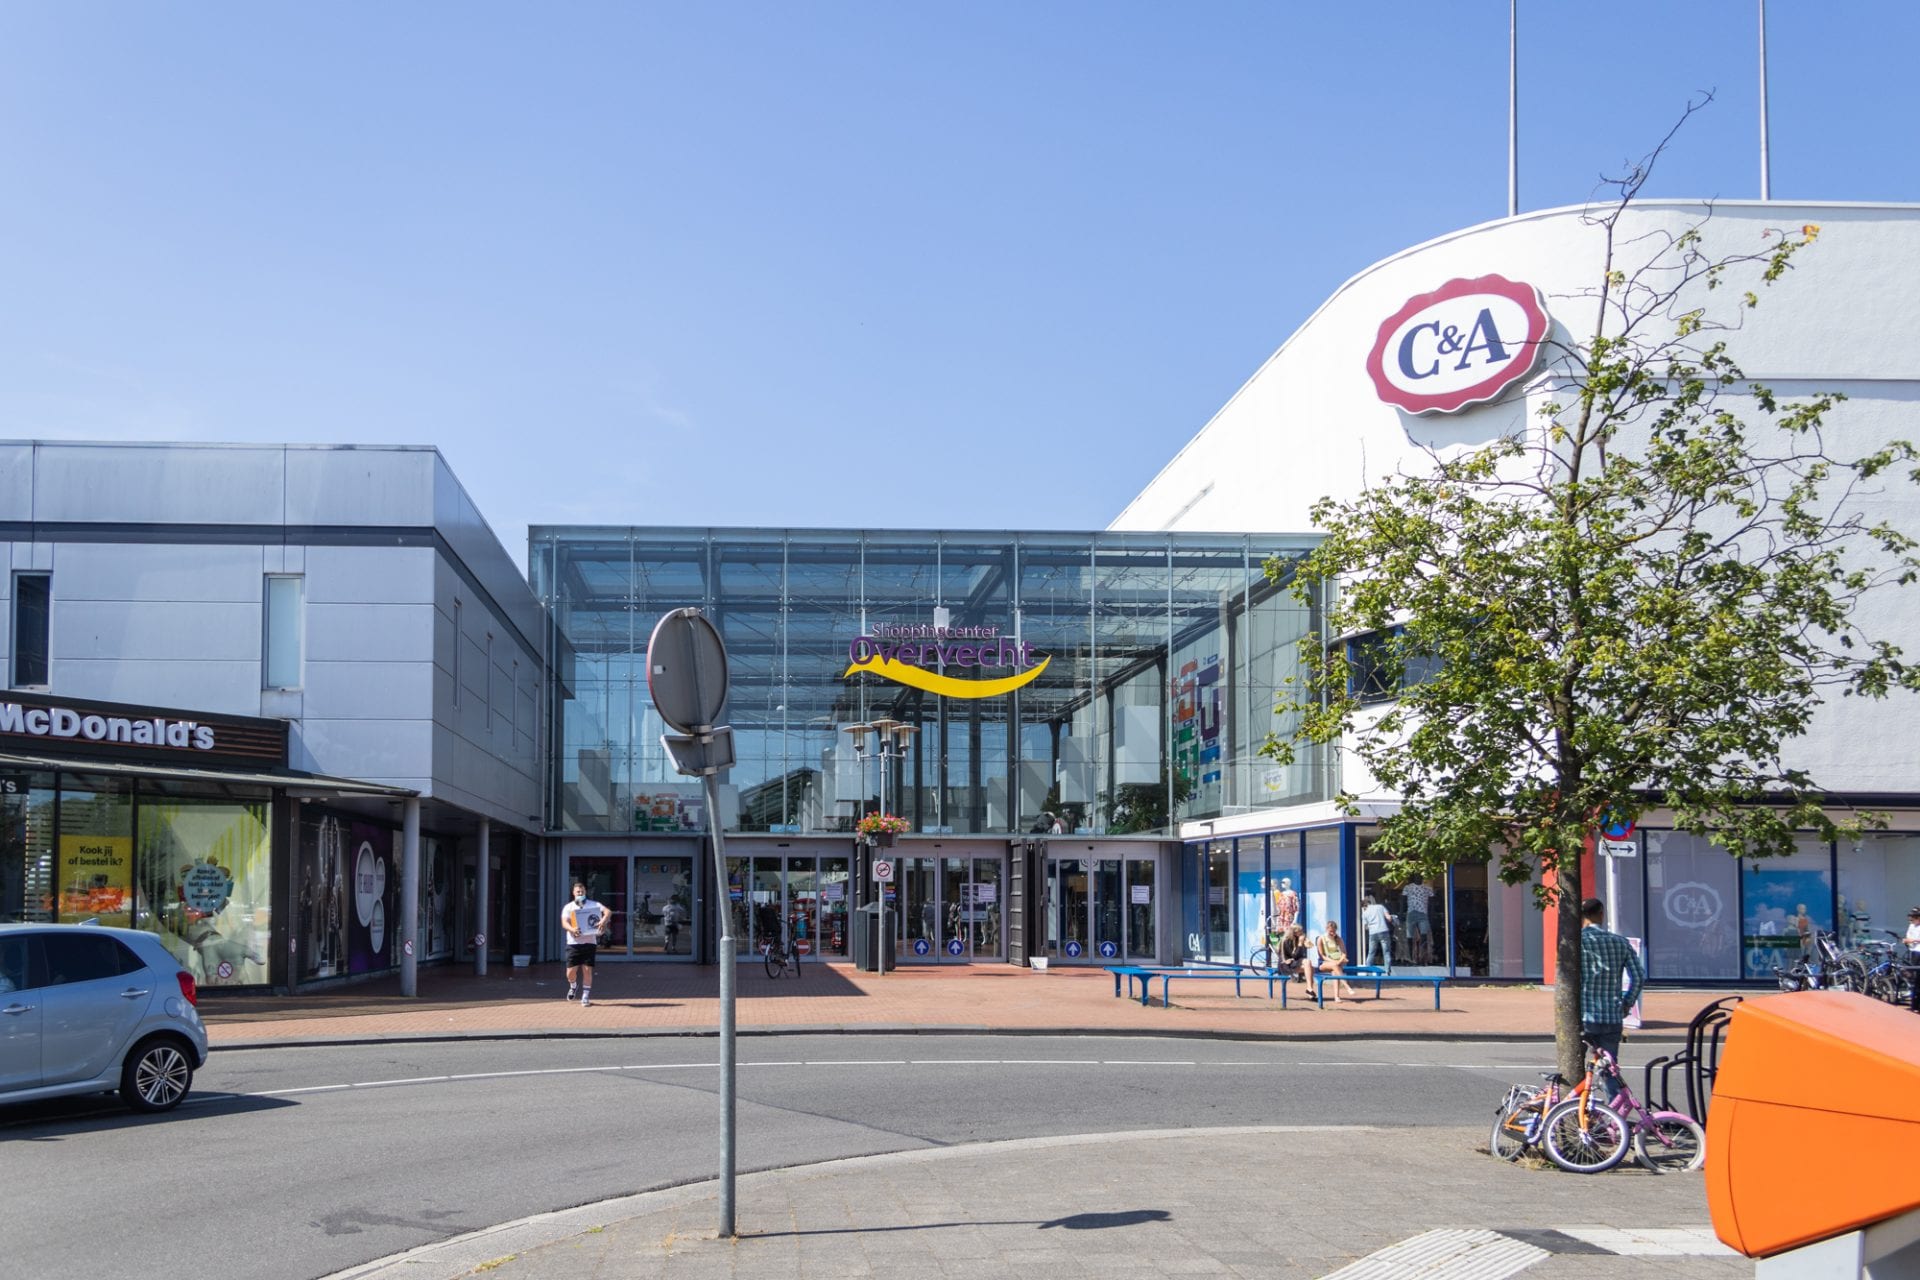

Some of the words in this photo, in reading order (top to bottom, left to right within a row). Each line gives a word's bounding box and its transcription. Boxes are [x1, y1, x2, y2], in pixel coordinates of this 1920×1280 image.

[1398, 307, 1511, 379] C&A
[871, 621, 999, 641] Shoppingcenter
[850, 636, 1036, 668] Overvecht
[0, 702, 215, 749] McDonald's
[68, 857, 78, 865] of
[80, 857, 108, 866] bestel
[110, 858, 123, 866] ik?
[80, 846, 103, 854] Kook
[104, 846, 113, 857] jij
[1673, 894, 1712, 914] C&A
